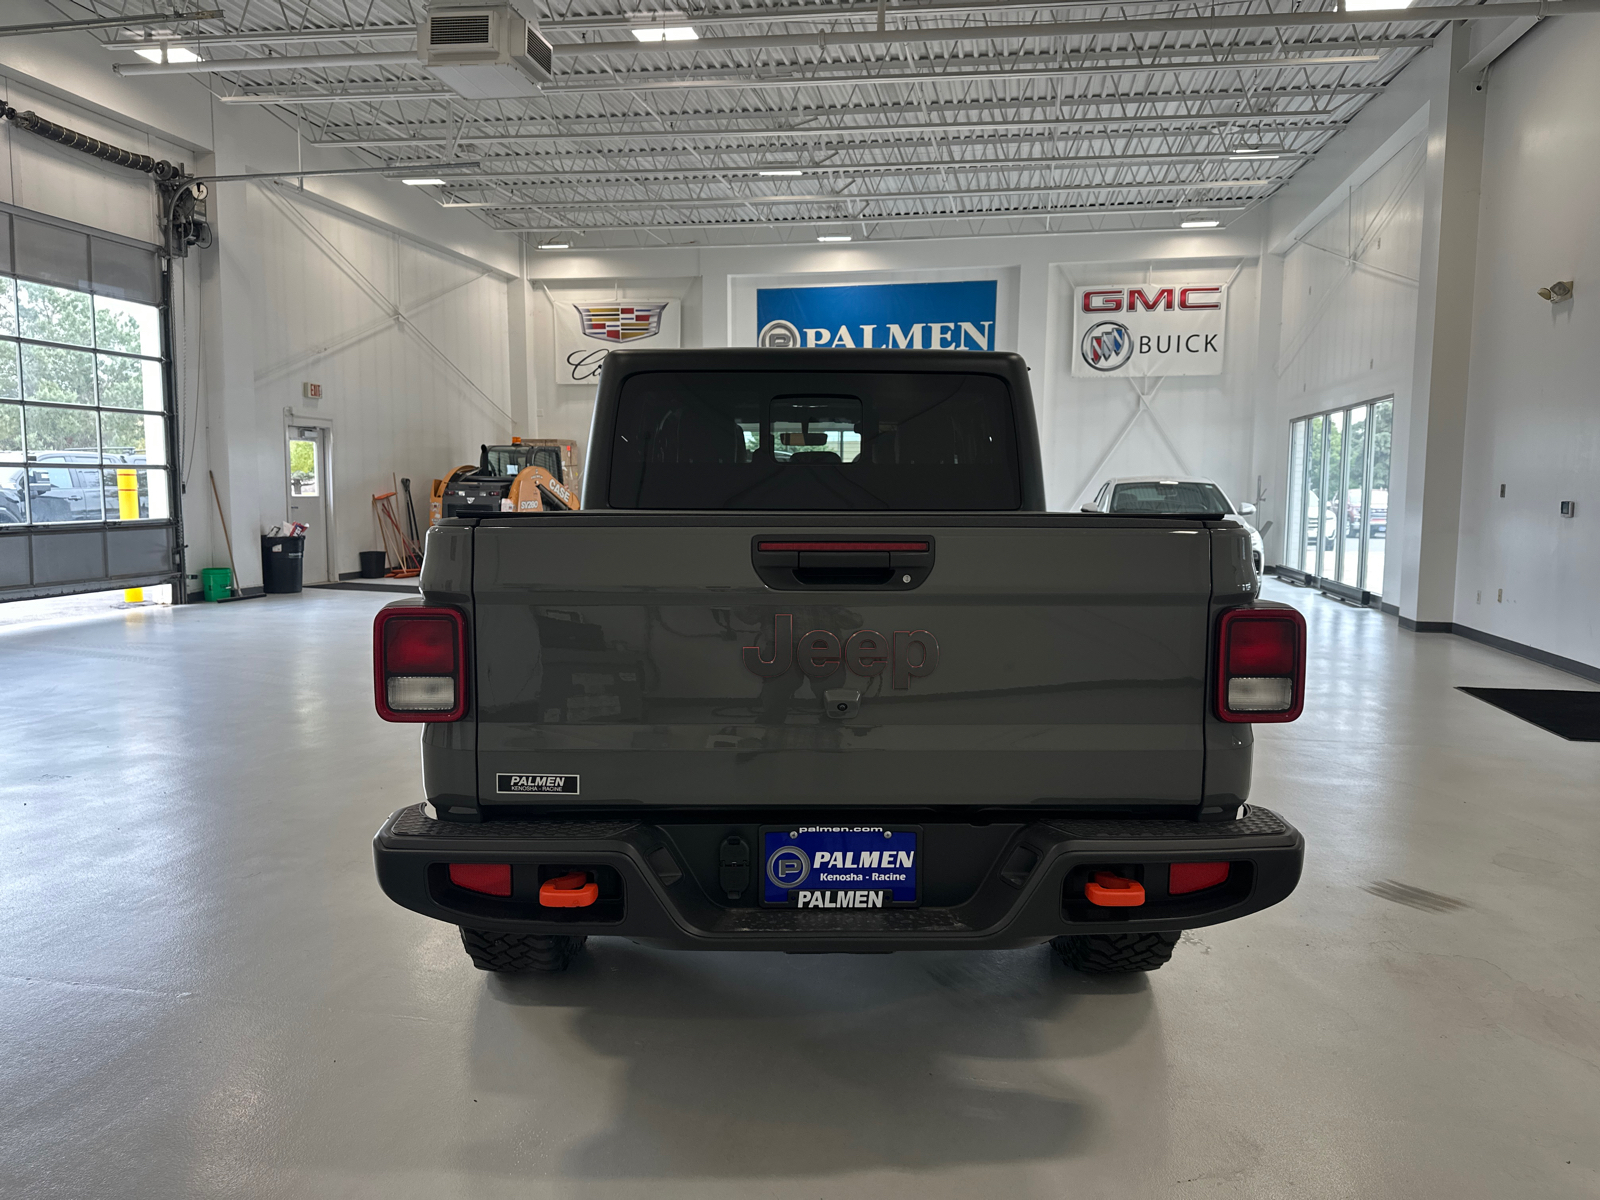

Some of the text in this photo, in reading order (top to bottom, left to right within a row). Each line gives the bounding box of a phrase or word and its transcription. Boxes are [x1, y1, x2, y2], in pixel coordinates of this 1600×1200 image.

[1081, 285, 1222, 314] GMC
[803, 321, 994, 350] PALMEN
[1139, 333, 1219, 354] BUICK
[549, 478, 571, 503] CASE
[742, 613, 940, 690] Jeep
[510, 776, 565, 787] PALMEN
[799, 825, 883, 834] palmen.com
[813, 851, 915, 869] PALMEN
[820, 872, 863, 882] Kenosha
[871, 872, 906, 882] Racine
[797, 890, 884, 909] PALMEN
